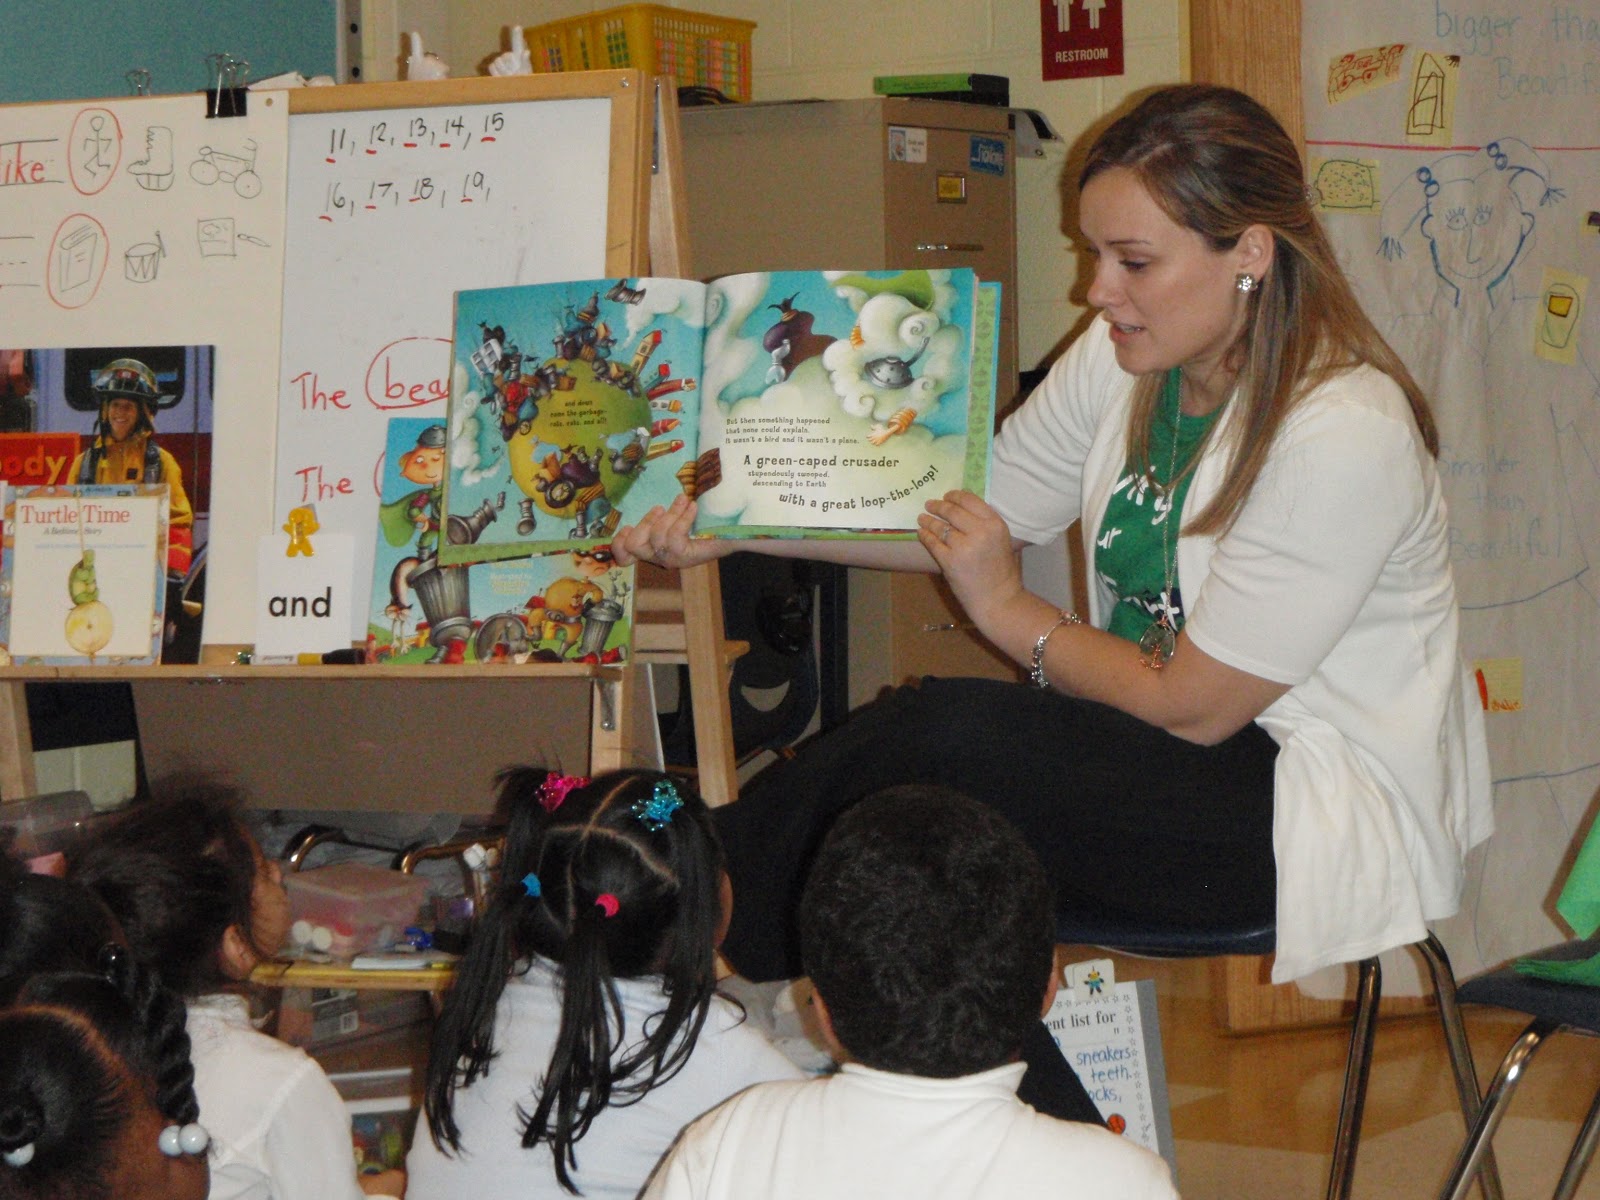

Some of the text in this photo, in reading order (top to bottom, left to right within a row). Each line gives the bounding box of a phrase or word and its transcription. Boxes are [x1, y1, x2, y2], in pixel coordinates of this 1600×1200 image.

[1055, 48, 1109, 62] RESTROOM
[484, 112, 504, 133] 15
[0, 142, 46, 185] ike
[290, 356, 453, 411] The bea
[726, 427, 740, 435] that
[758, 417, 794, 425] something
[796, 417, 830, 426] happened
[733, 436, 756, 444] wasn't
[765, 435, 780, 443] bird
[0, 445, 67, 485] ody
[744, 455, 900, 469] A green-caped crusader
[295, 465, 354, 503] The
[748, 470, 795, 479] stupendously
[752, 480, 827, 489] descending to Earth
[779, 464, 939, 513] with a great loop-the-loop!
[21, 504, 131, 524] Turtle Time
[268, 586, 332, 618] and
[1046, 1010, 1117, 1031] ent list for
[1076, 1045, 1132, 1066] sneakers
[1087, 1086, 1123, 1104] ocks,
